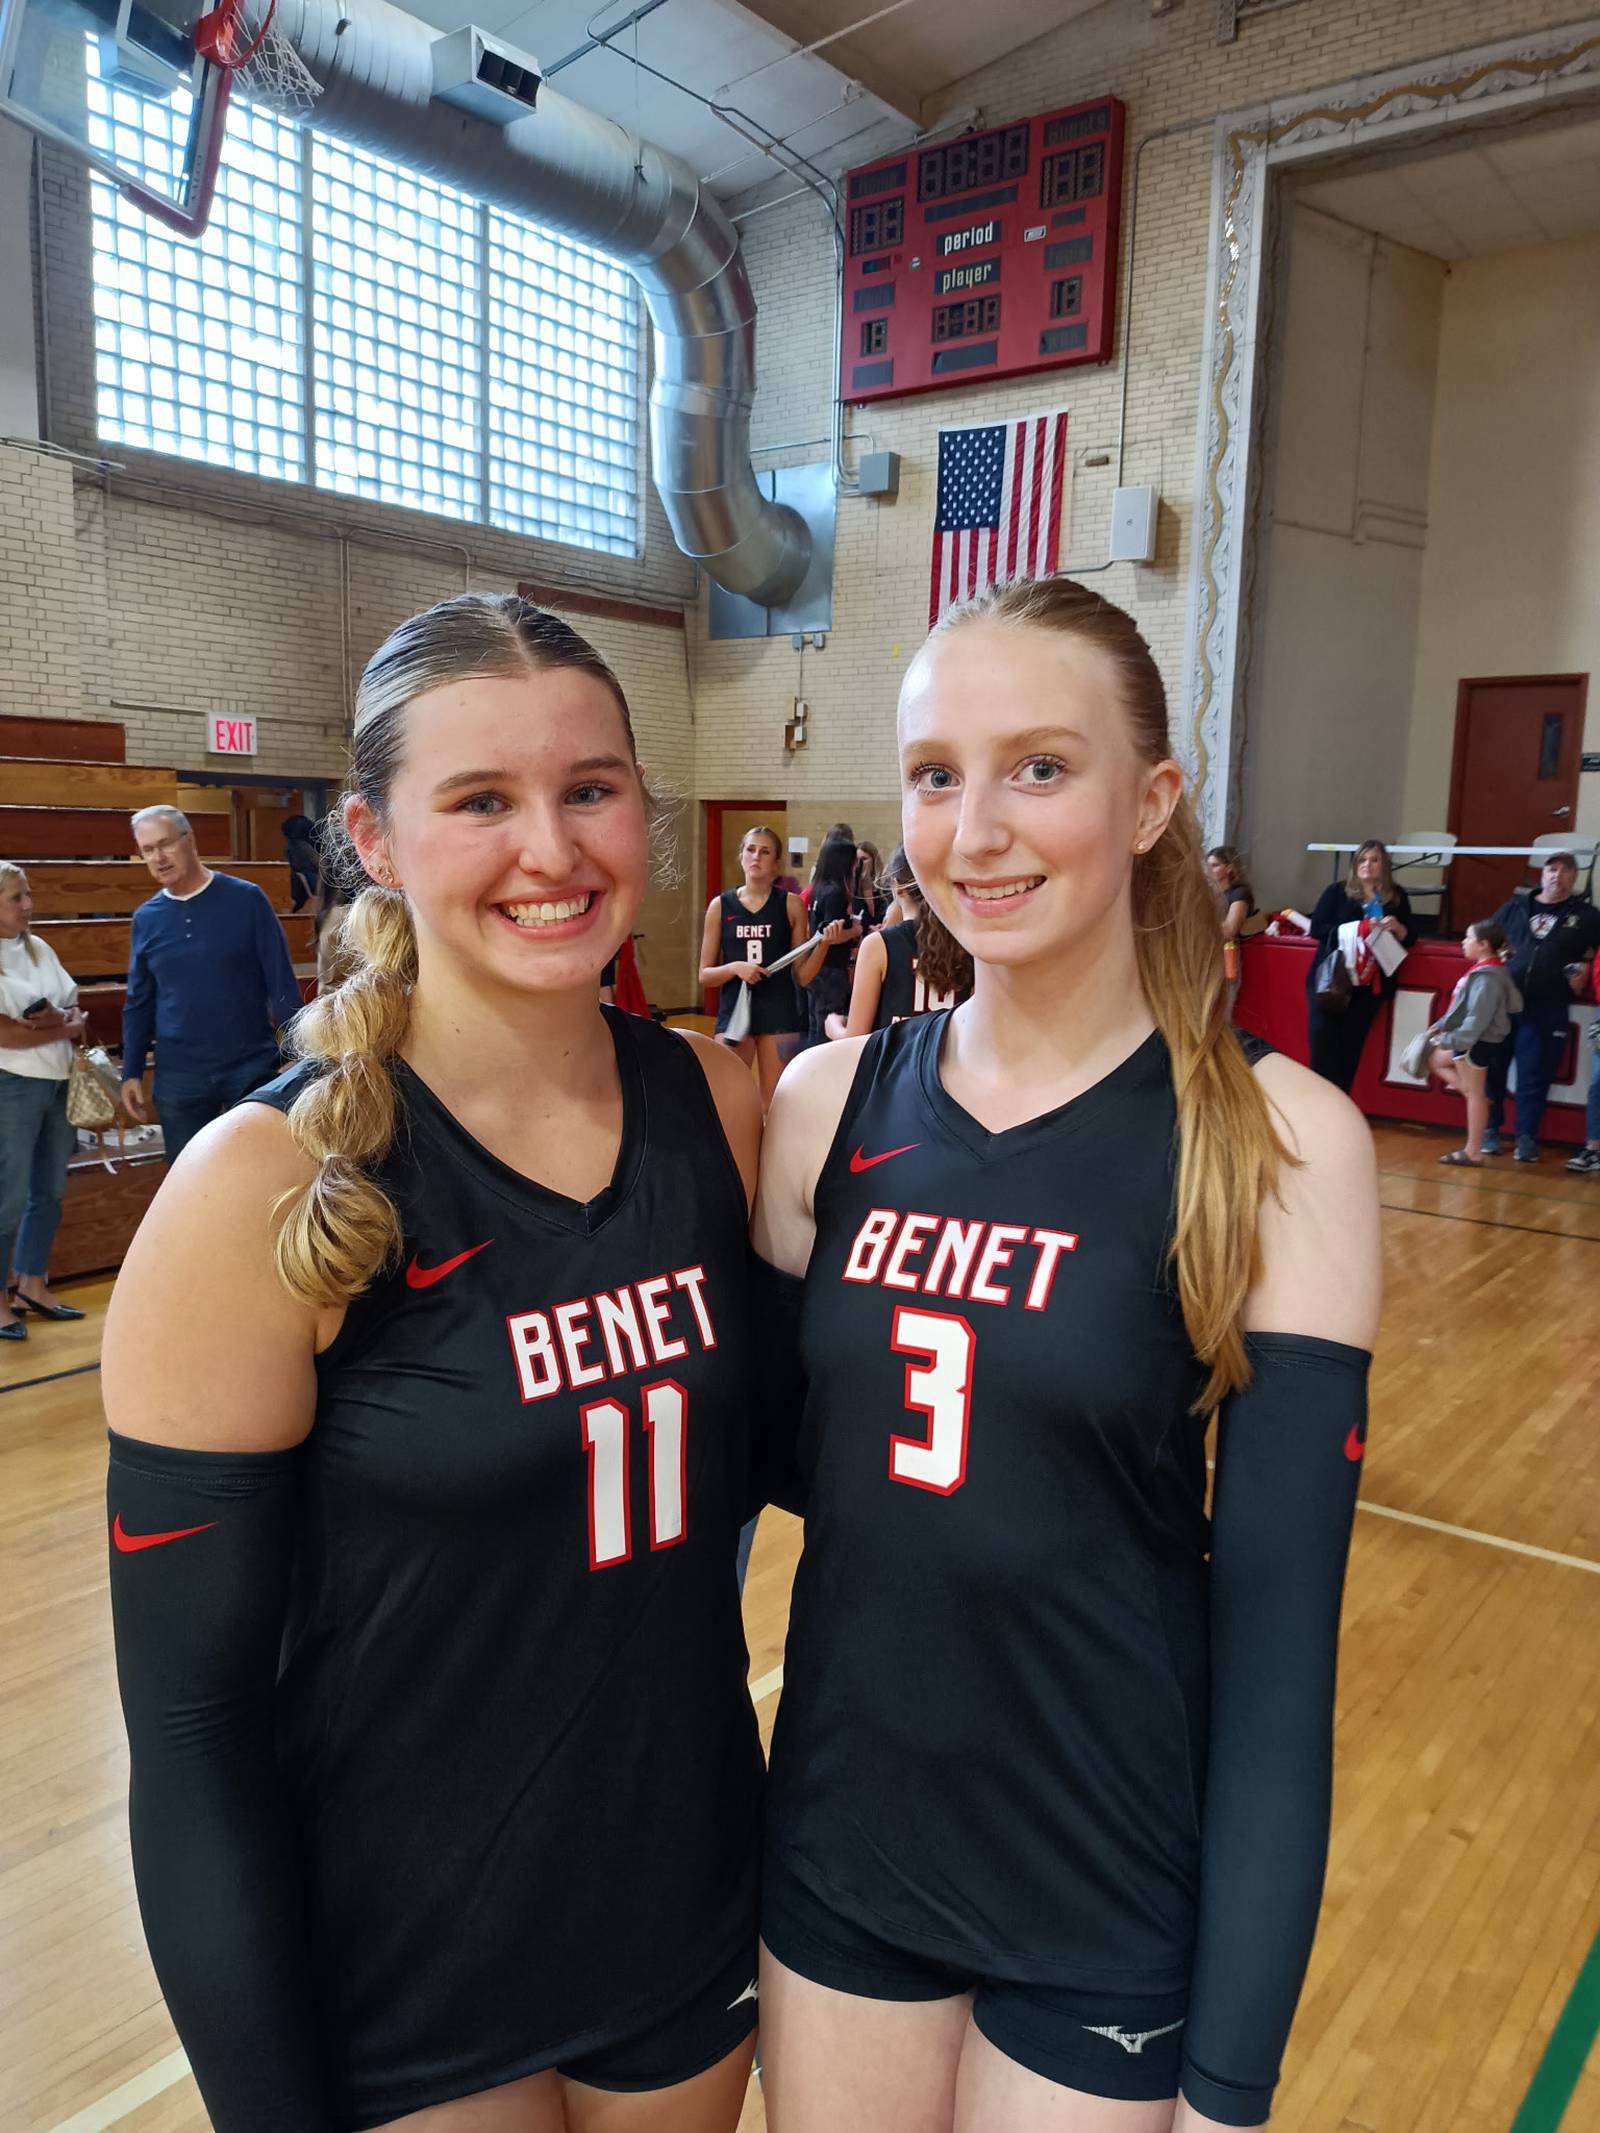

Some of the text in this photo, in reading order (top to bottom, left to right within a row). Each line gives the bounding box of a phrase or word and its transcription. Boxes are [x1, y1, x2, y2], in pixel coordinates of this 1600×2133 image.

[944, 221, 993, 257] period
[942, 264, 992, 295] player
[215, 720, 253, 752] EXIT
[736, 924, 772, 938] BENET
[747, 939, 763, 965] 8
[842, 1207, 1079, 1312] BENET
[506, 1264, 718, 1405] BENET
[889, 1305, 976, 1497] 3
[579, 1378, 688, 1572] 11
